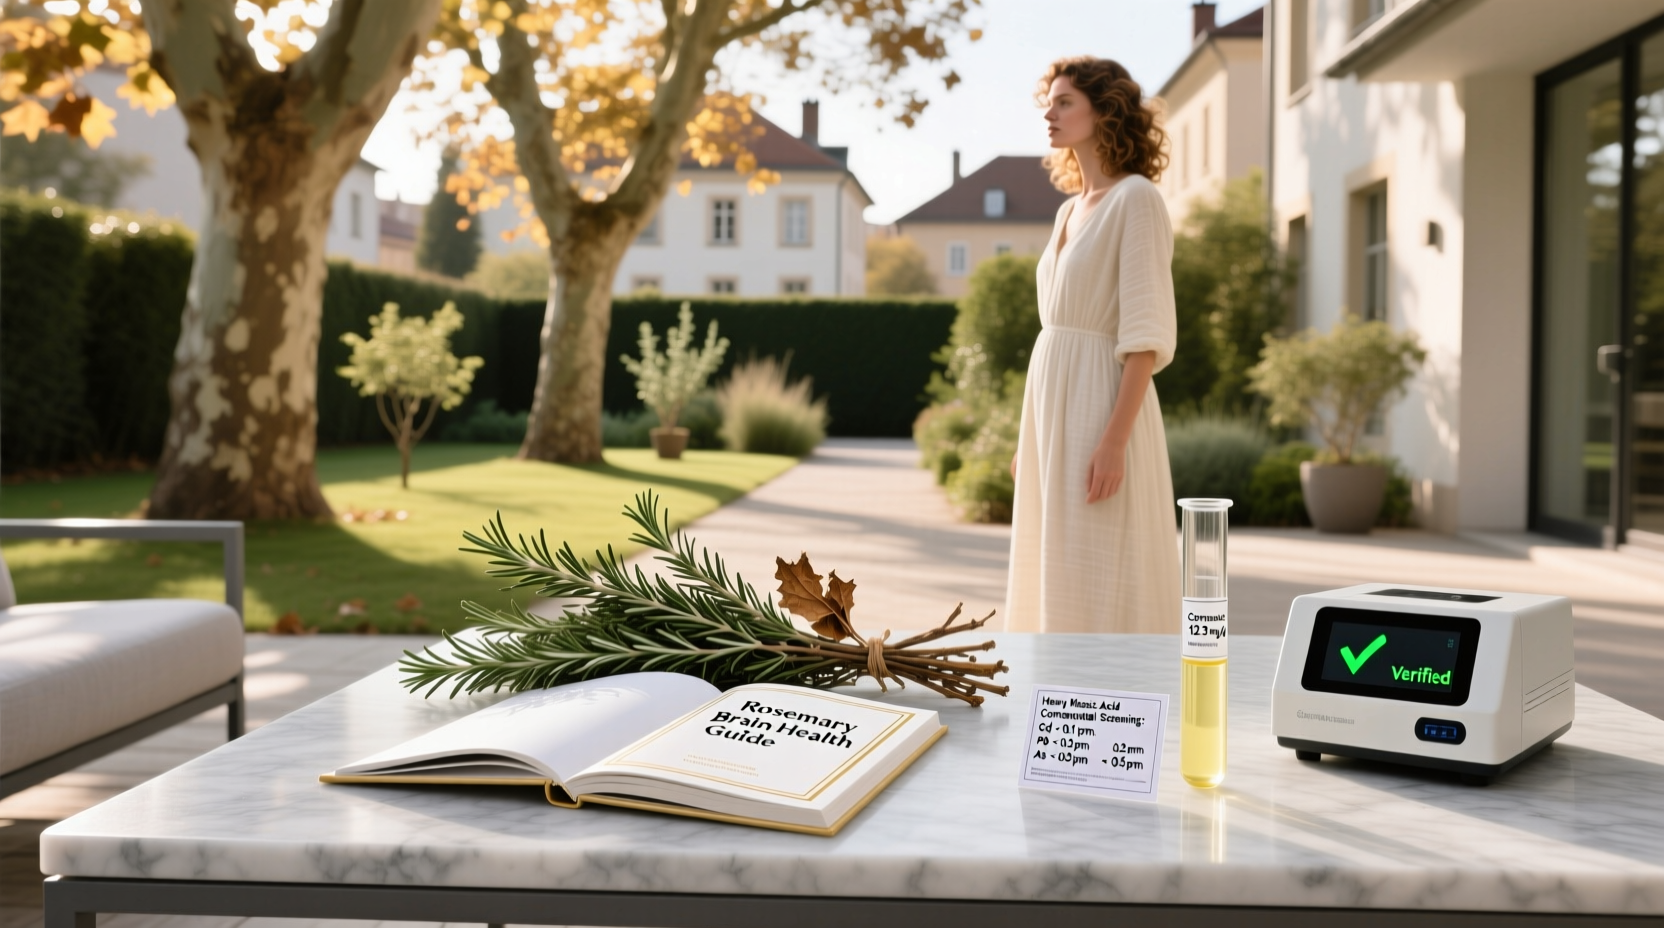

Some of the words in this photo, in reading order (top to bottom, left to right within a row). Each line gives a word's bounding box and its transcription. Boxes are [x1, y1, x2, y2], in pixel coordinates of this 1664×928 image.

[1391, 665, 1451, 685] Verified
[710, 711, 772, 731] Brain
[776, 723, 852, 748] Health
[740, 700, 858, 735] Rosemary
[705, 725, 776, 747] Guide
